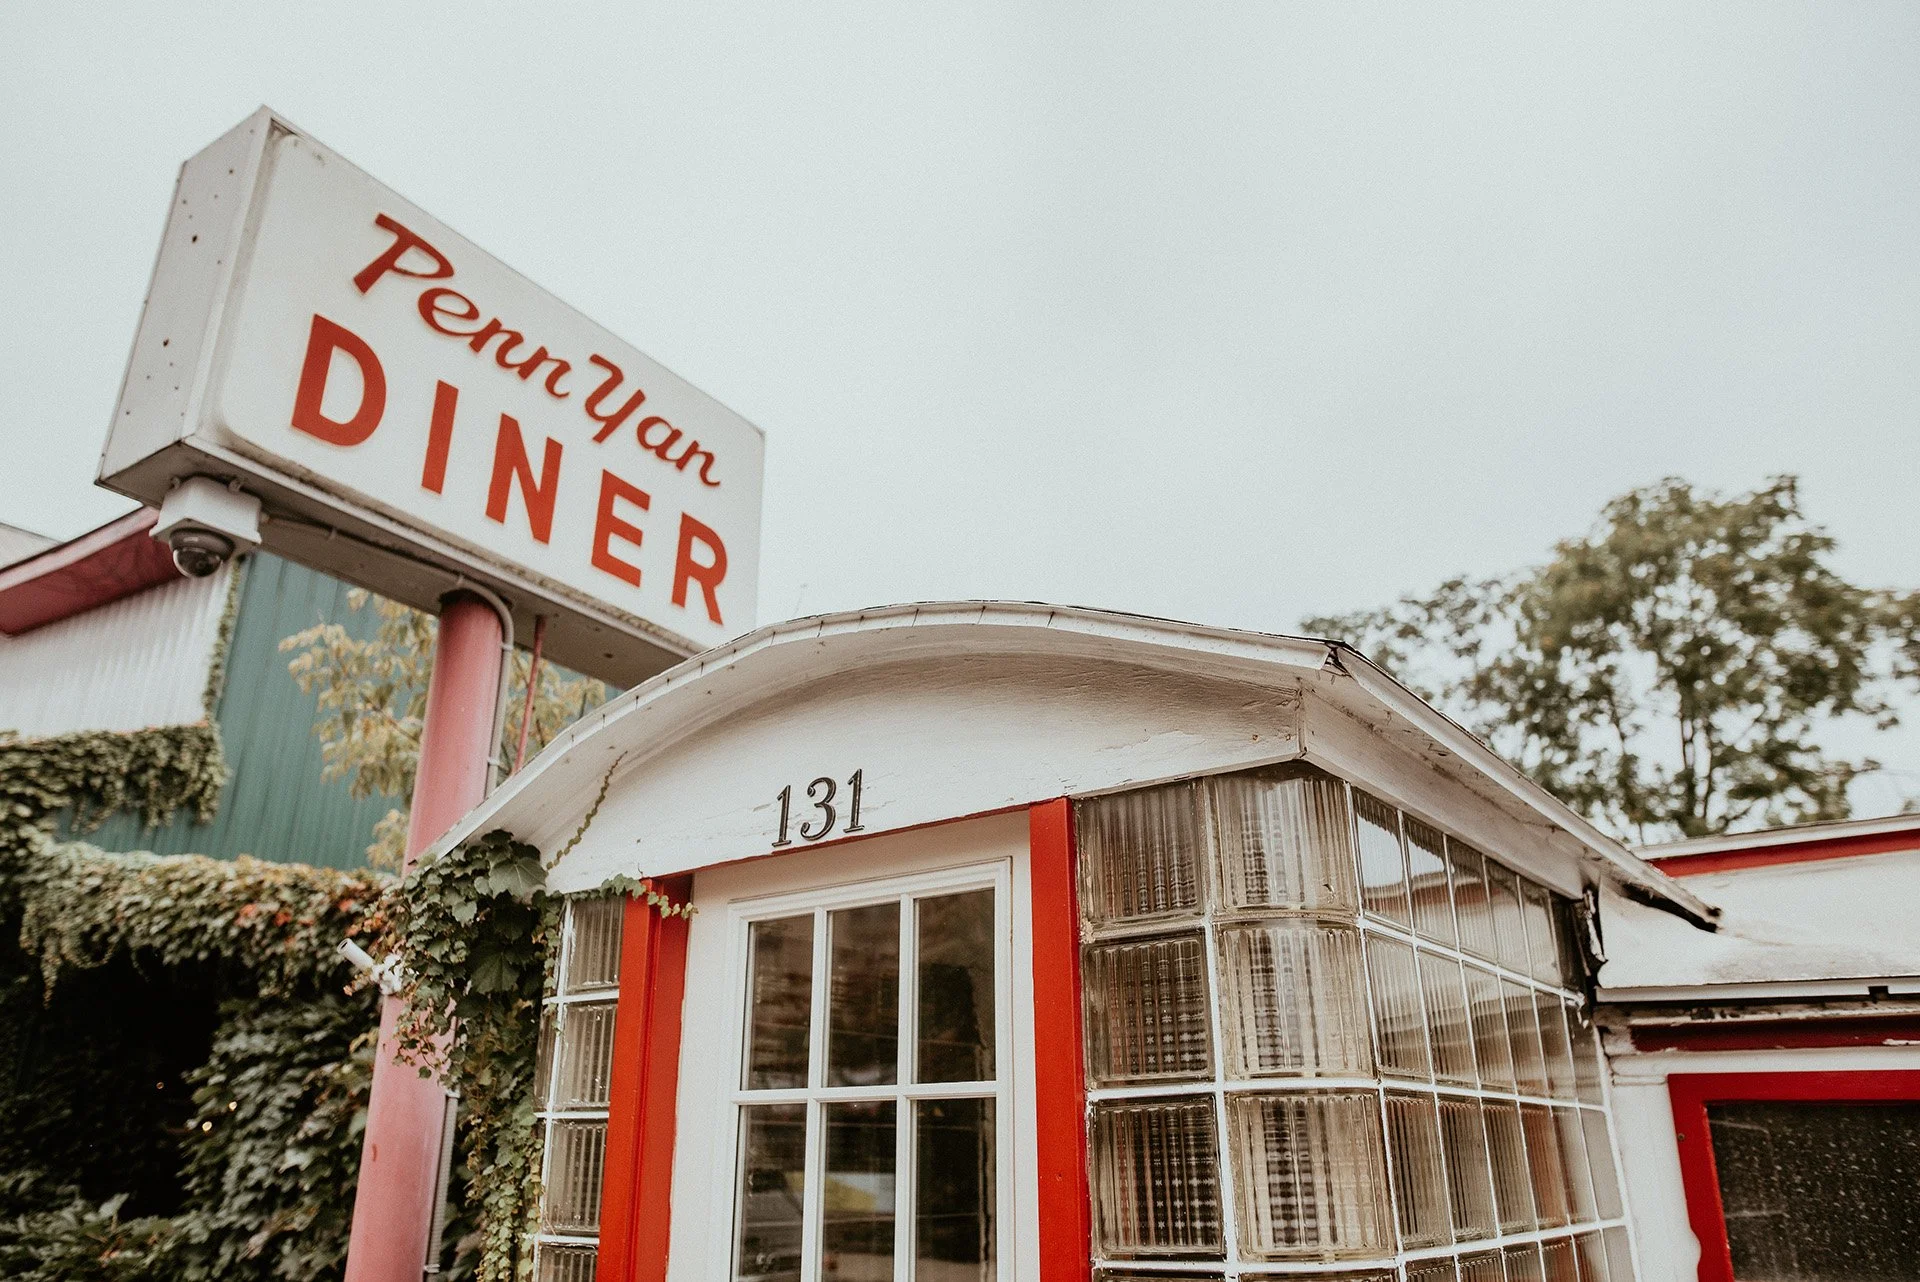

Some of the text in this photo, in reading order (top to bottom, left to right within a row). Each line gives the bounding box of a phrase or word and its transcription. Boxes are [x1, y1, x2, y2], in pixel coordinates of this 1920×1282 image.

[290, 312, 729, 627] DINER
[352, 212, 722, 488] Penn Yan
[771, 767, 865, 848] 131
